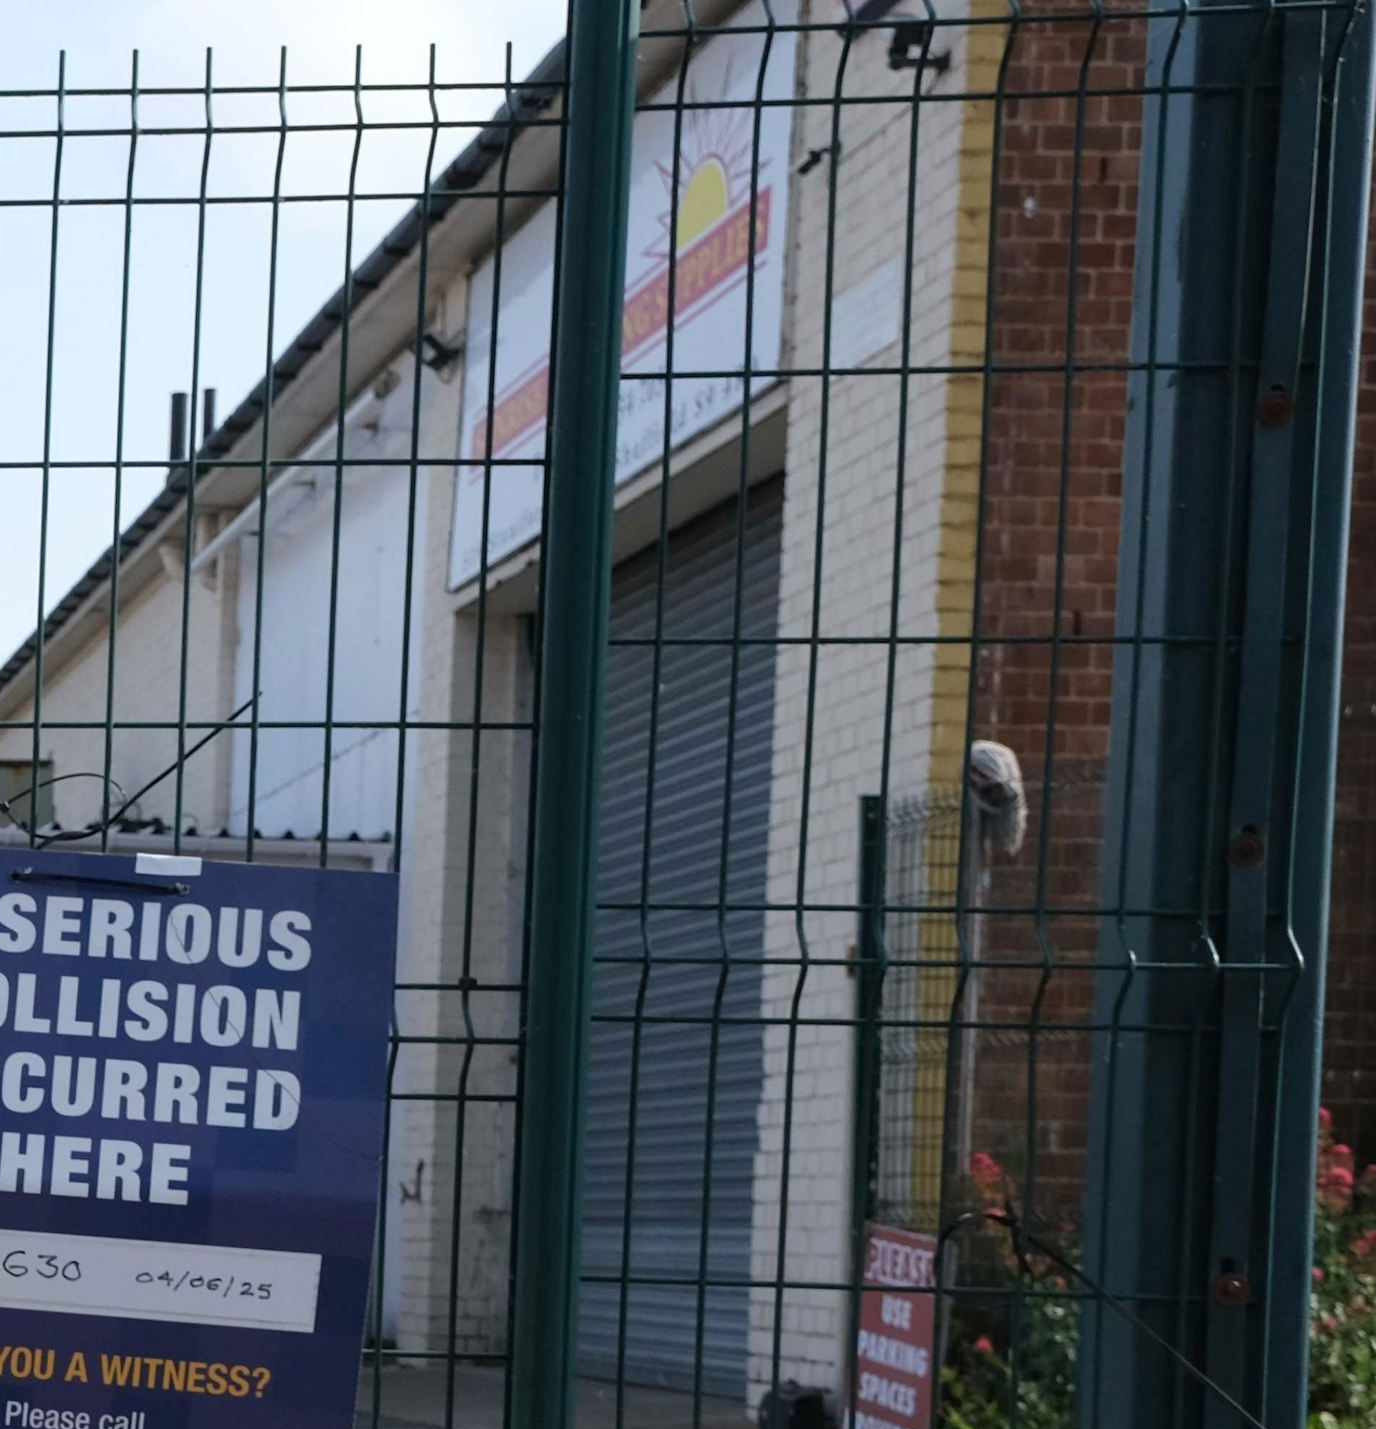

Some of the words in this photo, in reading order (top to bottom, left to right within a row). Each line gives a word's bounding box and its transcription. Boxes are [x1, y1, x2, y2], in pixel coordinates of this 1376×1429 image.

[134, 1270, 273, 1300] 04/06/25
[881, 1294, 912, 1330] USE
[64, 1352, 89, 1383] A
[100, 1353, 272, 1398] WITNESS?
[857, 1329, 929, 1378] PARKING
[859, 1371, 917, 1417] SPACES
